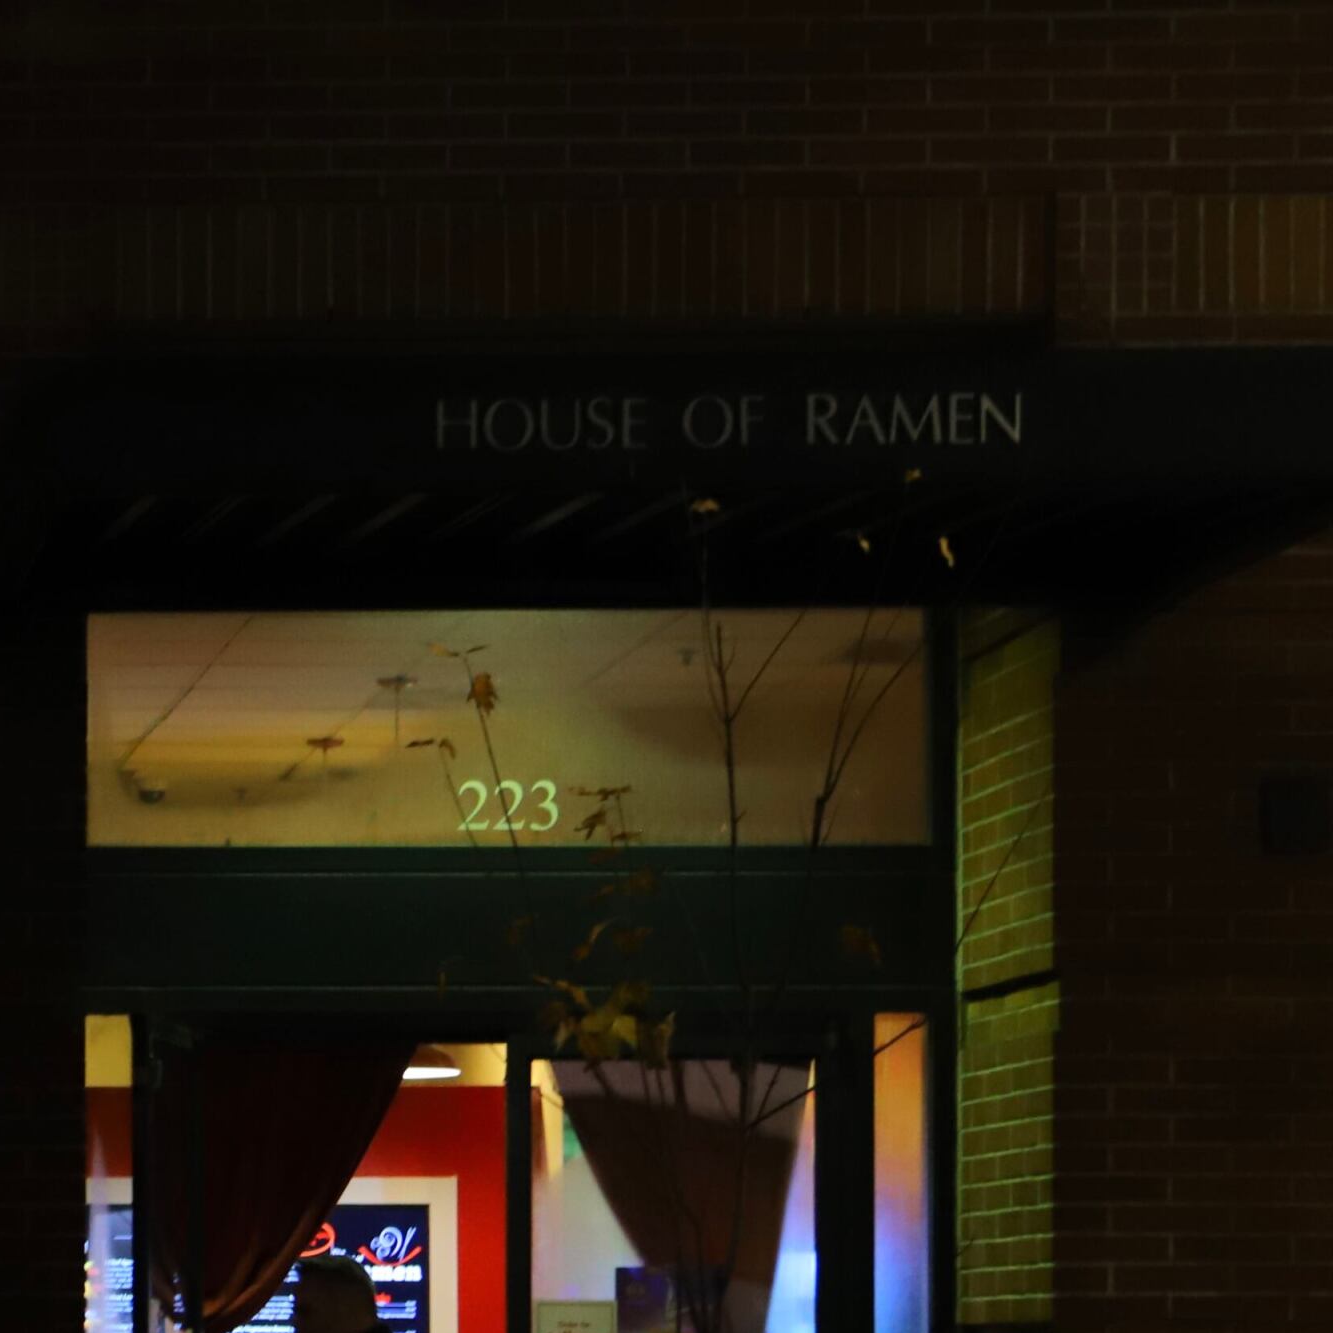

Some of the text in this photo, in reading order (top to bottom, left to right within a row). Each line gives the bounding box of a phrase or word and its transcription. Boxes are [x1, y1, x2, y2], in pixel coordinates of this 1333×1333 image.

[435, 391, 1024, 451] HOUSE OF RAMEN
[457, 779, 559, 832] 223
